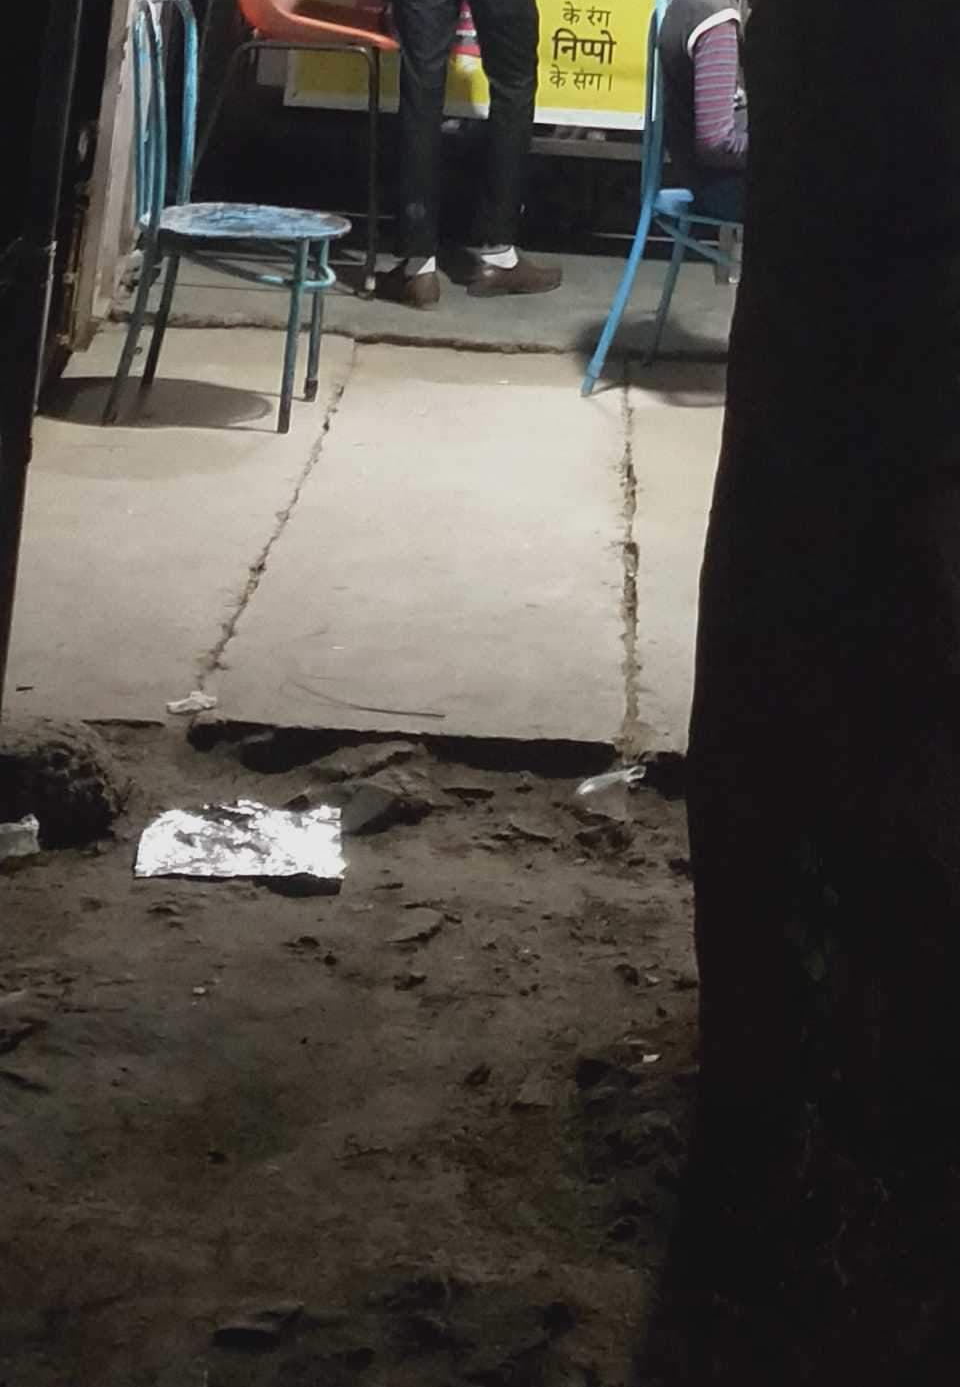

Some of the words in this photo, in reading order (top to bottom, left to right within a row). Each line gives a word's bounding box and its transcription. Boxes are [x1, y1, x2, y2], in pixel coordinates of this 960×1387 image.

[563, 1, 582, 26] के
[587, 6, 611, 26] रंग
[552, 27, 616, 64] निप्पो
[550, 64, 568, 89] के
